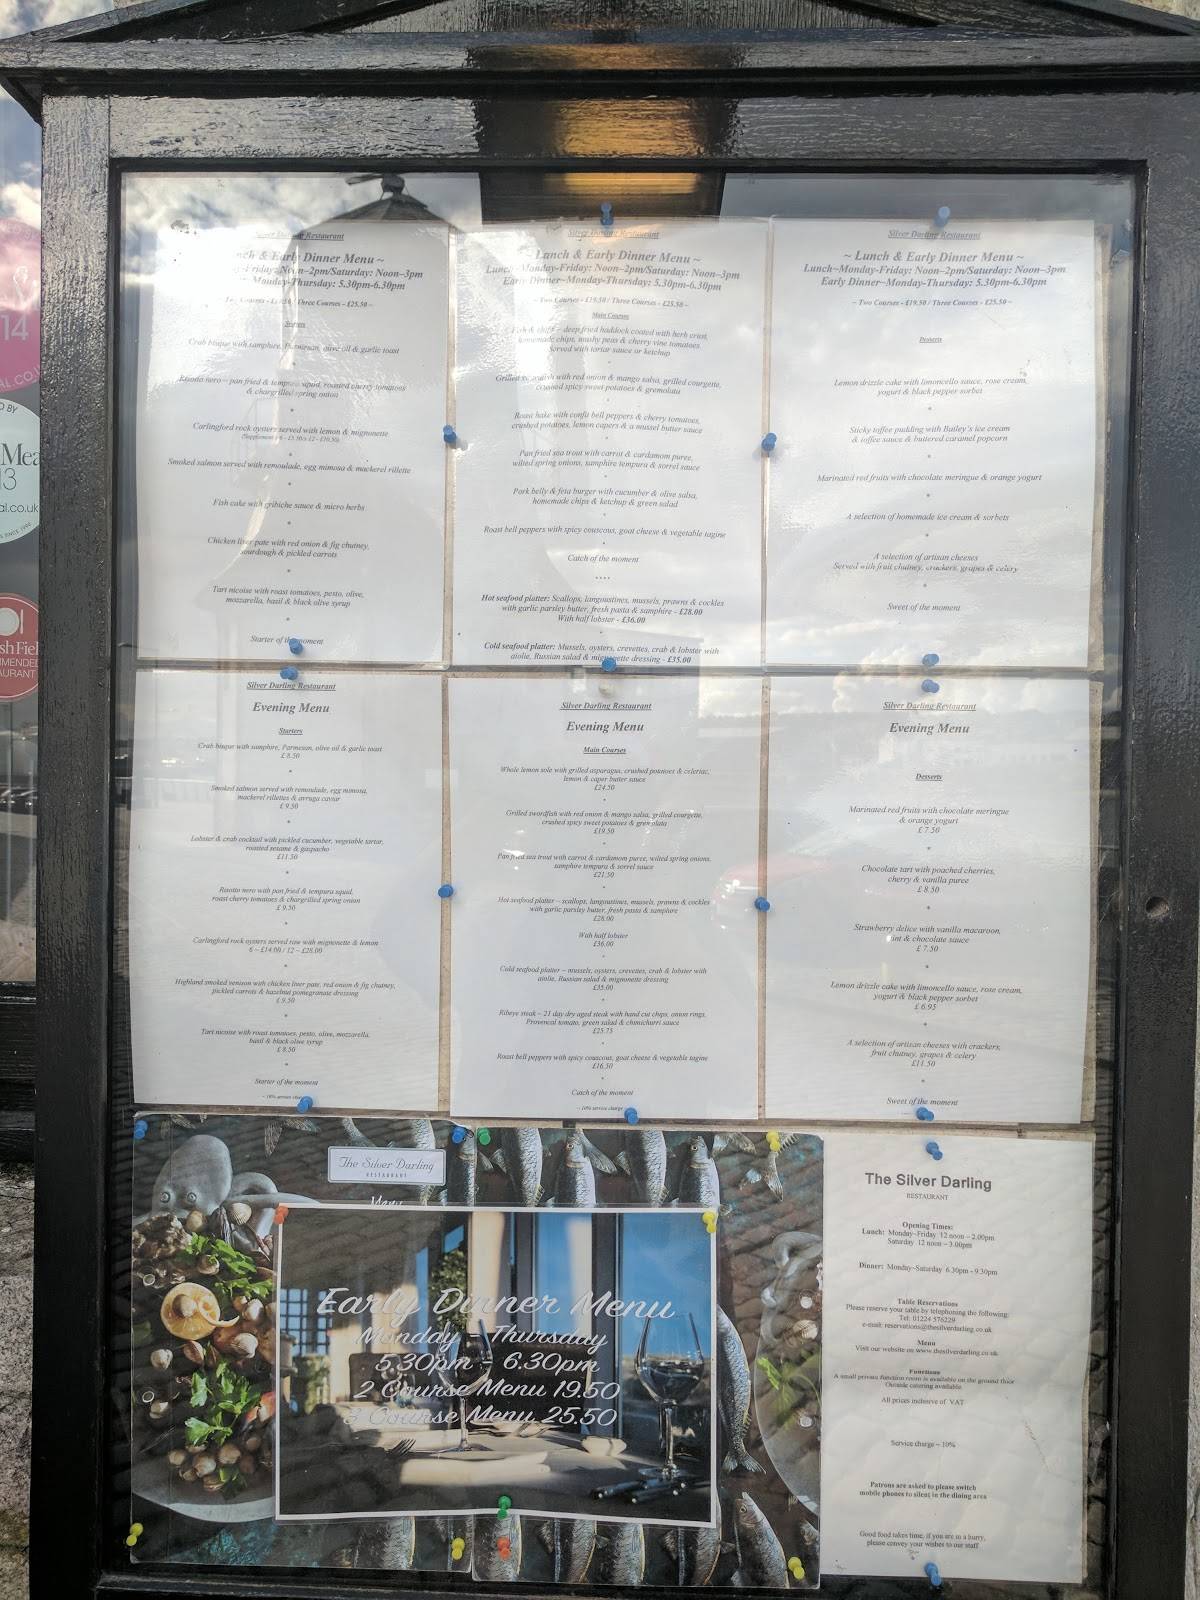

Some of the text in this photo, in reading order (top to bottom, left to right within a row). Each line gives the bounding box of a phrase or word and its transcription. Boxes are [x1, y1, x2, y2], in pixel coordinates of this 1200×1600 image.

[306, 231, 344, 241] Restaurant
[303, 252, 375, 265] Dinner Menu
[586, 249, 616, 262] Early
[618, 250, 657, 262] Dinner
[659, 252, 691, 263] Menu
[854, 250, 1014, 264] Lunch & Early Dinner Menu
[821, 276, 846, 288] Early
[849, 425, 873, 435] Sticky
[874, 425, 891, 435] toffee
[892, 425, 924, 435] pudding
[925, 425, 942, 433] with
[974, 424, 985, 432] ice
[345, 502, 365, 511] herbs
[567, 554, 588, 562] Catch
[481, 594, 550, 604] Hot seafood platter:
[558, 614, 574, 622] With
[575, 615, 590, 624] half
[591, 615, 614, 623] lobster
[246, 681, 336, 691] Silver Darling Restaurant
[252, 701, 330, 715] Evening Menu
[560, 701, 652, 711] Silver Darling Restaurant
[883, 701, 904, 711] Silver
[906, 702, 935, 711] Darling
[278, 727, 303, 736] Starters
[566, 721, 645, 733] Evening Menu
[889, 722, 970, 735] Evening Menu
[583, 746, 627, 755] Main Courses
[915, 773, 943, 781] Desserts
[861, 864, 899, 873] Chocolate
[900, 865, 914, 873] tart
[914, 865, 930, 874] with
[931, 866, 962, 876] poached
[338, 1156, 435, 1174] The Silver Darling
[865, 1172, 992, 1192] The Silver Darling
[906, 1193, 949, 1201] RESTAURANT
[902, 1221, 930, 1230] Opening
[862, 1228, 885, 1236] Lunch:
[887, 1238, 914, 1246] Saturday
[859, 1262, 884, 1270] Dinner:
[316, 1287, 676, 1328] Early Dinner Menu
[917, 1299, 959, 1307] Reservations
[356, 1325, 609, 1355] Monday Thursday
[375, 1351, 600, 1377] 5.30pm 6.30pm
[353, 1378, 621, 1400] 2 Course Menu 19.50
[369, 1407, 459, 1425] Course
[465, 1404, 536, 1423] Menu
[541, 1406, 618, 1426] 25.50
[890, 1439, 914, 1447] Service
[870, 1481, 895, 1489] Patrons
[908, 1482, 927, 1490] asked
[935, 1483, 955, 1492] please
[956, 1483, 977, 1491] switch
[882, 1490, 904, 1499] phones
[939, 1491, 950, 1499] the
[951, 1491, 972, 1501] dining
